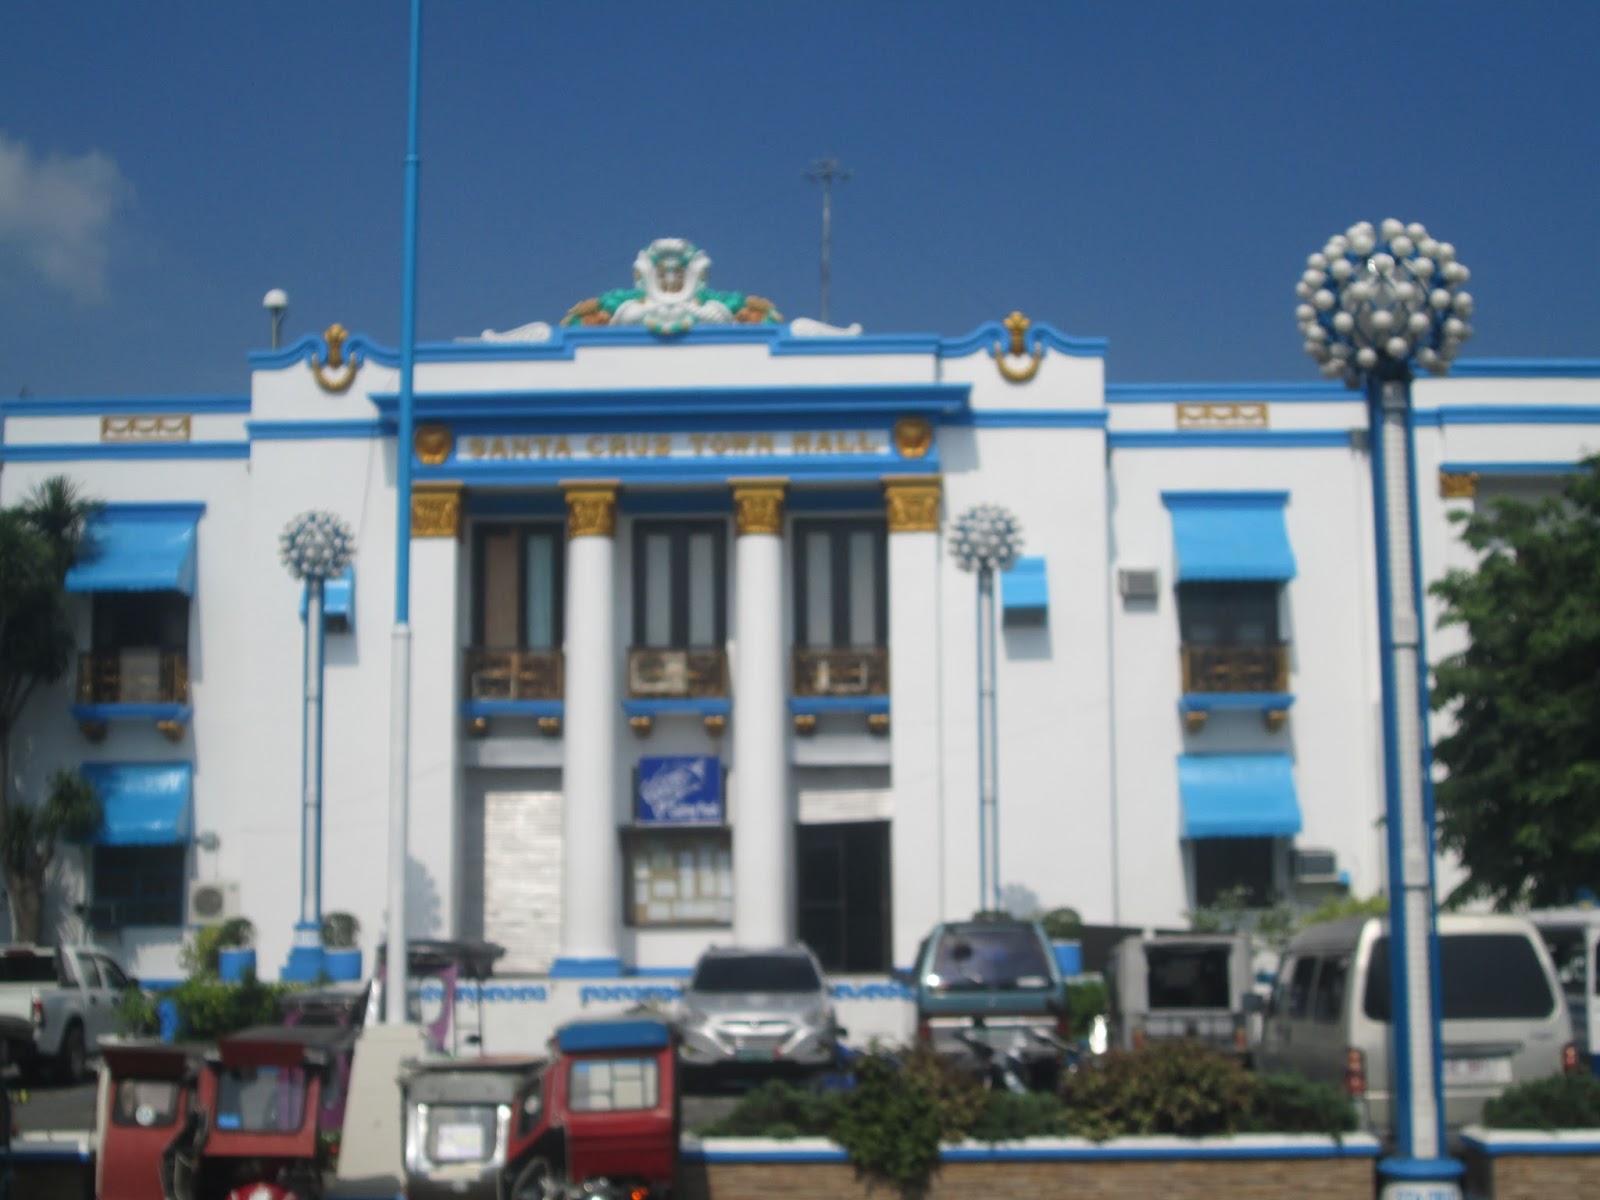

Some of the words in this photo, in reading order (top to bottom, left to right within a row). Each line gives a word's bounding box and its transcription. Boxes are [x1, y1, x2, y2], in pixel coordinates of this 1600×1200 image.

[468, 435, 571, 459] SANTA
[586, 433, 672, 457] CRUZ
[688, 431, 774, 456] TOWN
[792, 430, 878, 455] HALL
